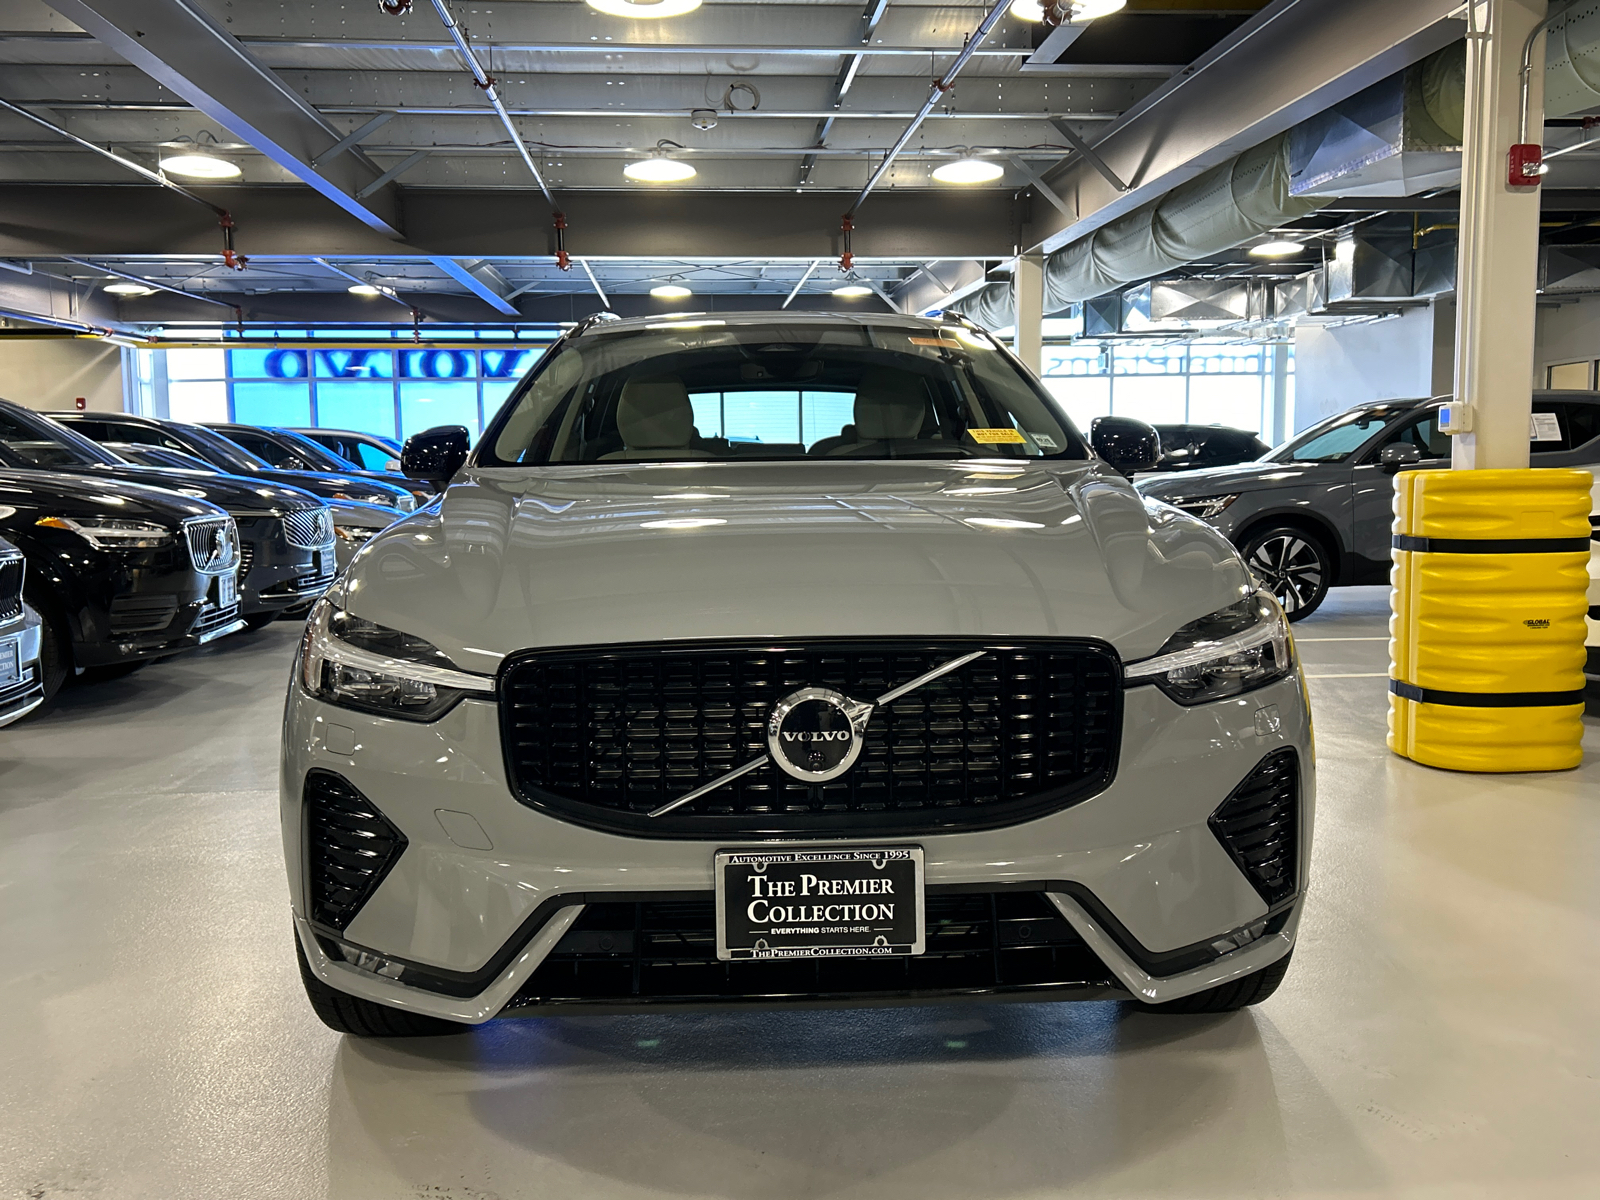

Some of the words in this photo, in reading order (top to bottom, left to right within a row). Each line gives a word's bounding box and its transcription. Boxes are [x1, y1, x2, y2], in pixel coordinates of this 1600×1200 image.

[782, 730, 850, 742] VOLVO
[731, 855, 792, 864] AUTOMOTIVE
[795, 853, 851, 862] EXCELLENCE
[853, 852, 880, 860] SINCE
[884, 850, 909, 859] 1995
[747, 875, 796, 897] THE
[800, 874, 895, 896] PREMIER
[747, 899, 895, 923] COLLECTION
[771, 927, 820, 935] EVERYTHING
[821, 926, 848, 934] STARTS
